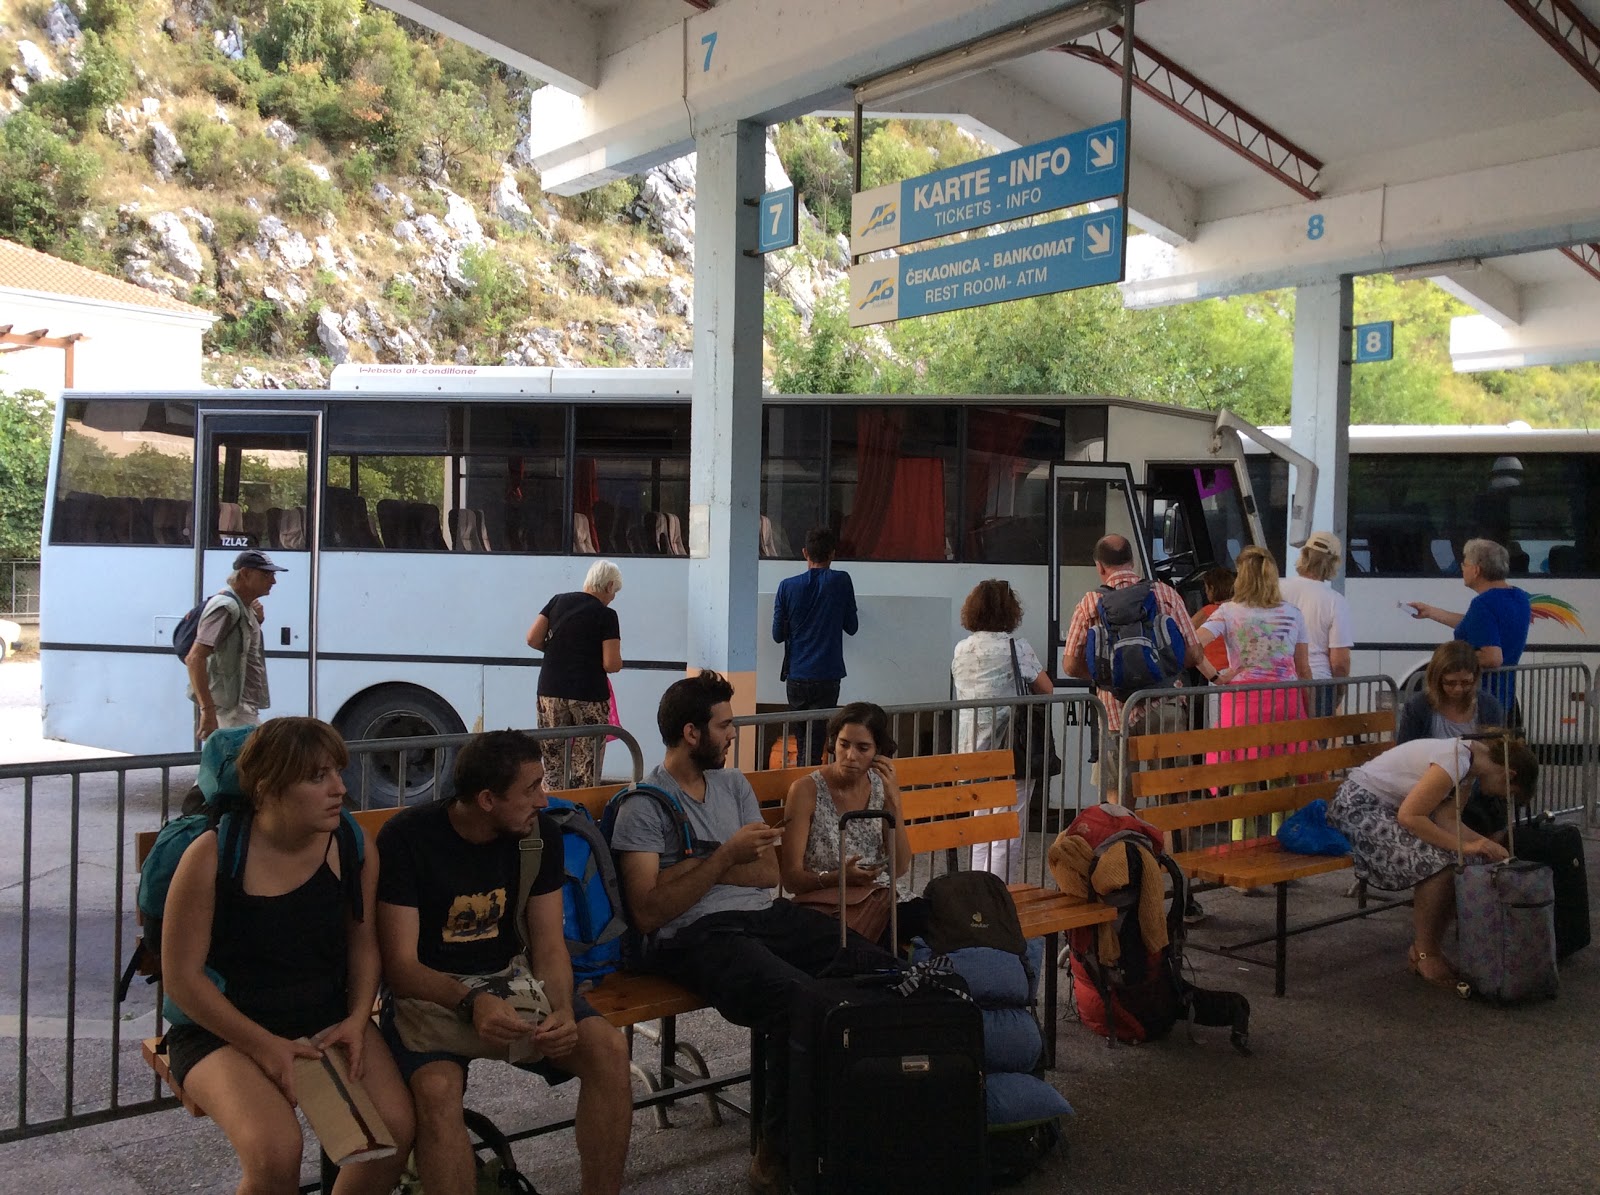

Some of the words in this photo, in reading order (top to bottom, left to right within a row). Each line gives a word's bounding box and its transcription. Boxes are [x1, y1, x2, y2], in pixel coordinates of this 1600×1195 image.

[701, 31, 718, 72] 7
[913, 167, 990, 212] KARTE
[934, 200, 991, 227] TICKETS
[1006, 187, 1042, 210] INFO
[769, 203, 783, 236] 7
[1307, 214, 1325, 240] 8
[905, 257, 981, 287] ČEKAONICA
[994, 237, 1075, 269] BANKOMAT
[925, 284, 957, 304] REST
[1016, 266, 1048, 287] ATM
[1366, 331, 1382, 353] 8
[222, 538, 248, 546] IZLAZ
